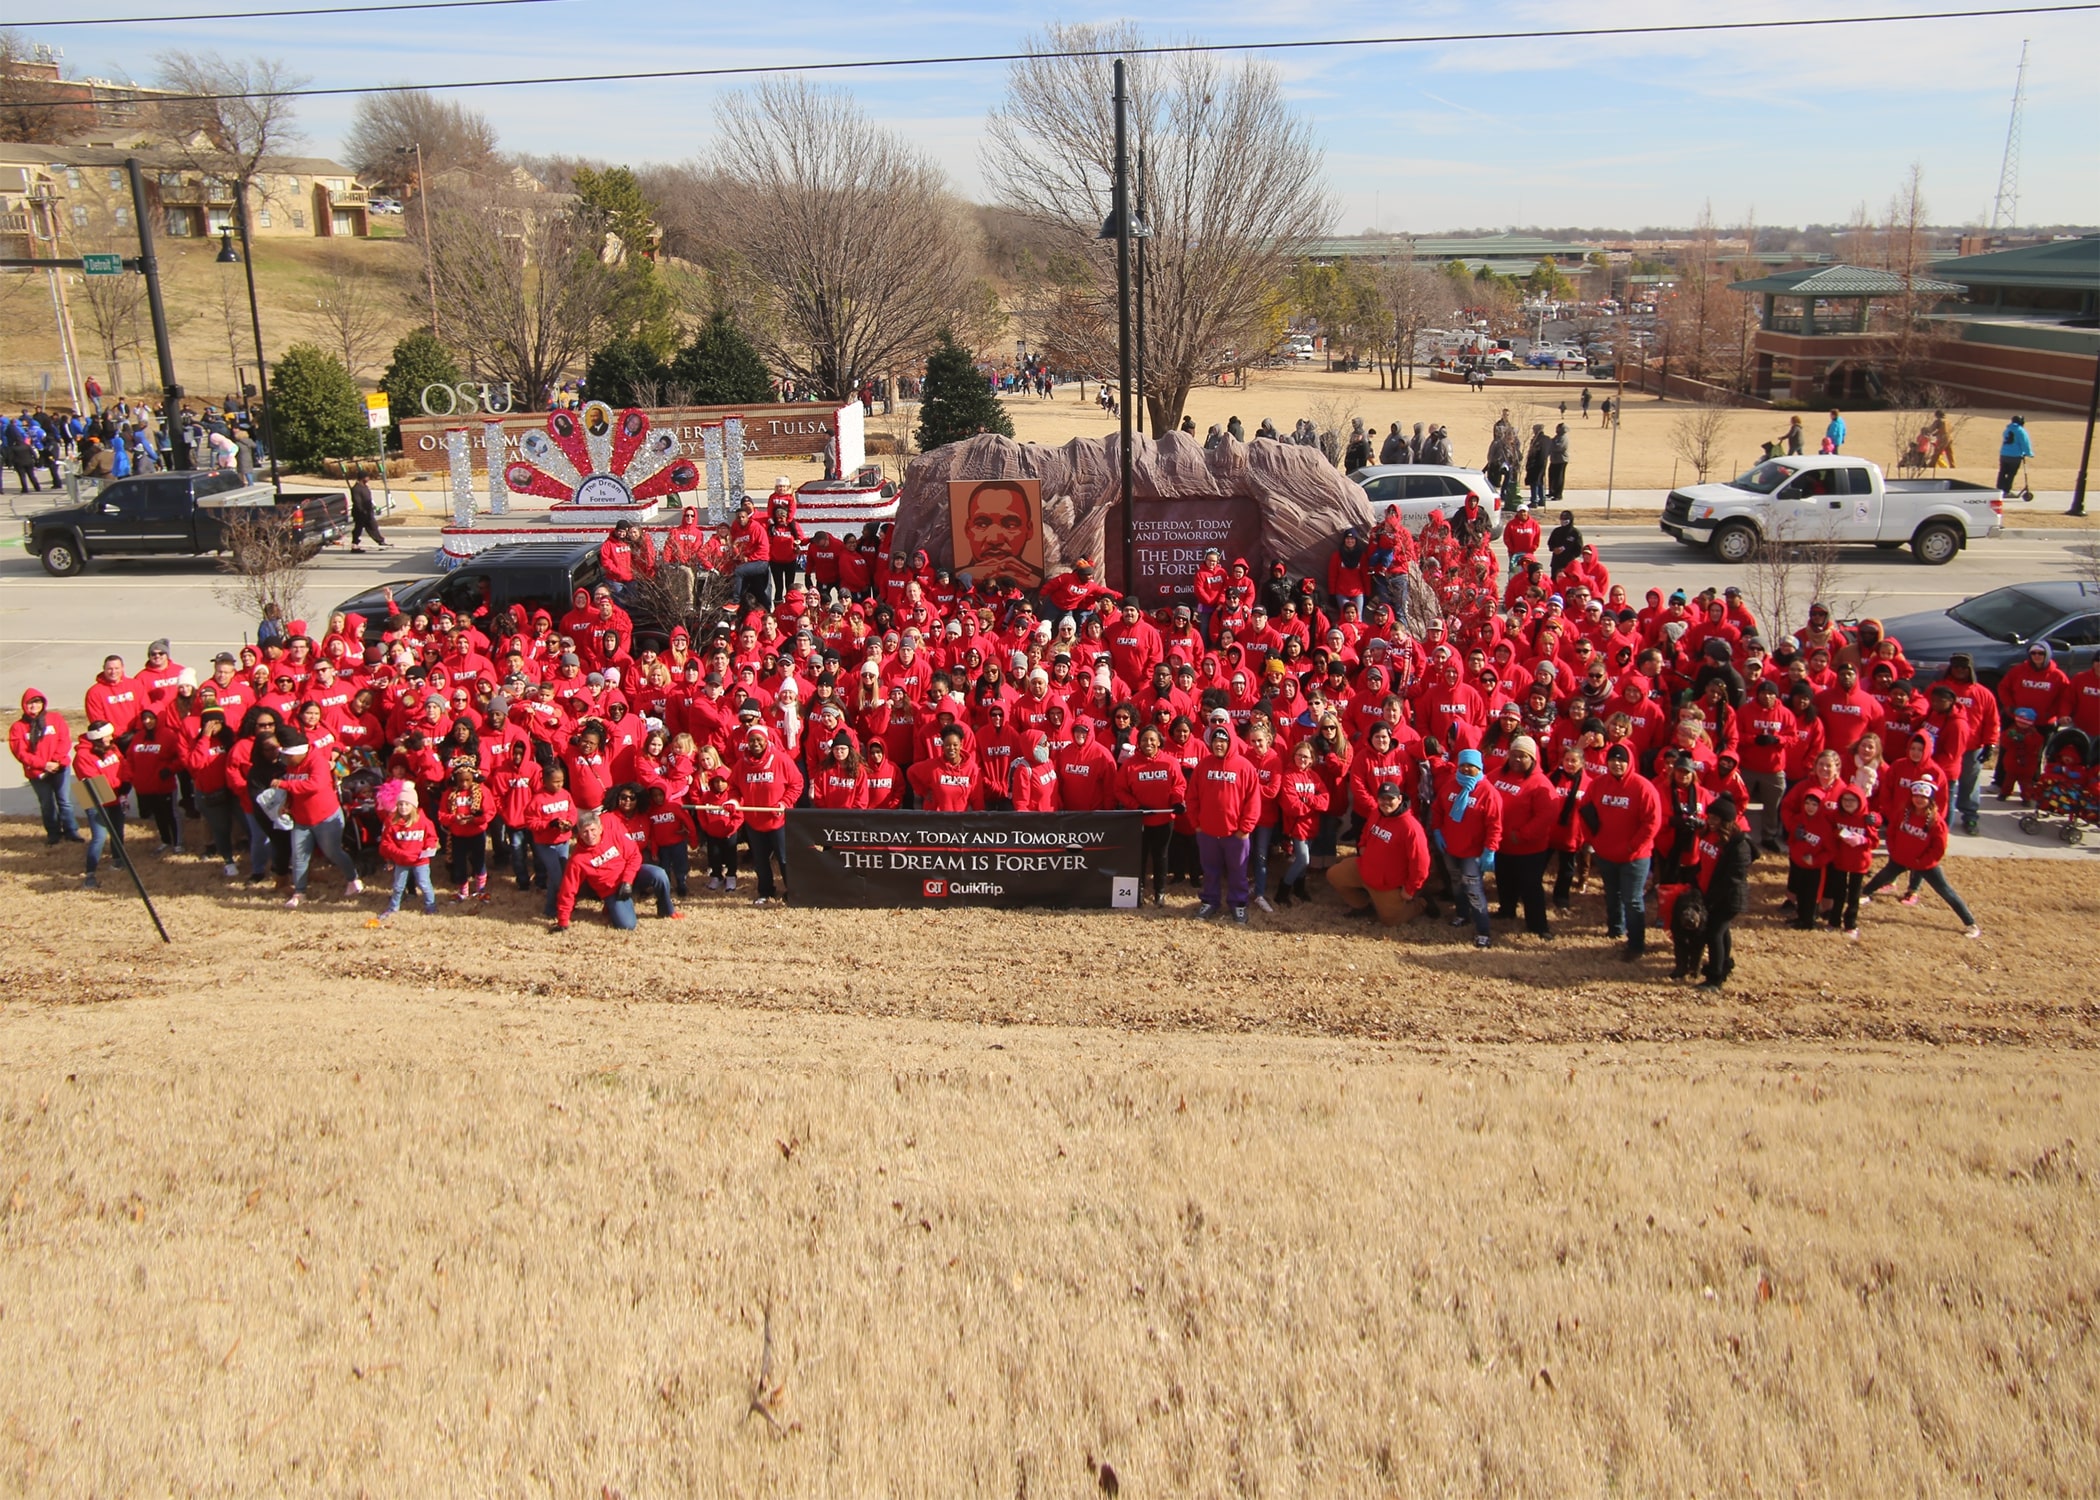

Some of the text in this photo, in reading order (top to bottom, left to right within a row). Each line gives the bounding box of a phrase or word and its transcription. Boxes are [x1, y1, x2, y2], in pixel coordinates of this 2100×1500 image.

[89, 259, 112, 271] Detroit
[420, 382, 513, 417] OSU
[768, 420, 828, 436] TULSA
[585, 480, 622, 494] The Dream
[1131, 519, 1233, 531] YESTERDAY, TODAY
[1135, 530, 1229, 541] AND TOMORROW
[1137, 549, 1169, 562] THE
[1142, 564, 1155, 576] IS
[823, 829, 1105, 845] YESTERDAY, TODAY AND TOMORROW
[840, 850, 1088, 872] THE DREAM IS FOREVER
[925, 881, 1004, 896] QT QuikTrip
[1119, 887, 1132, 897] 24
